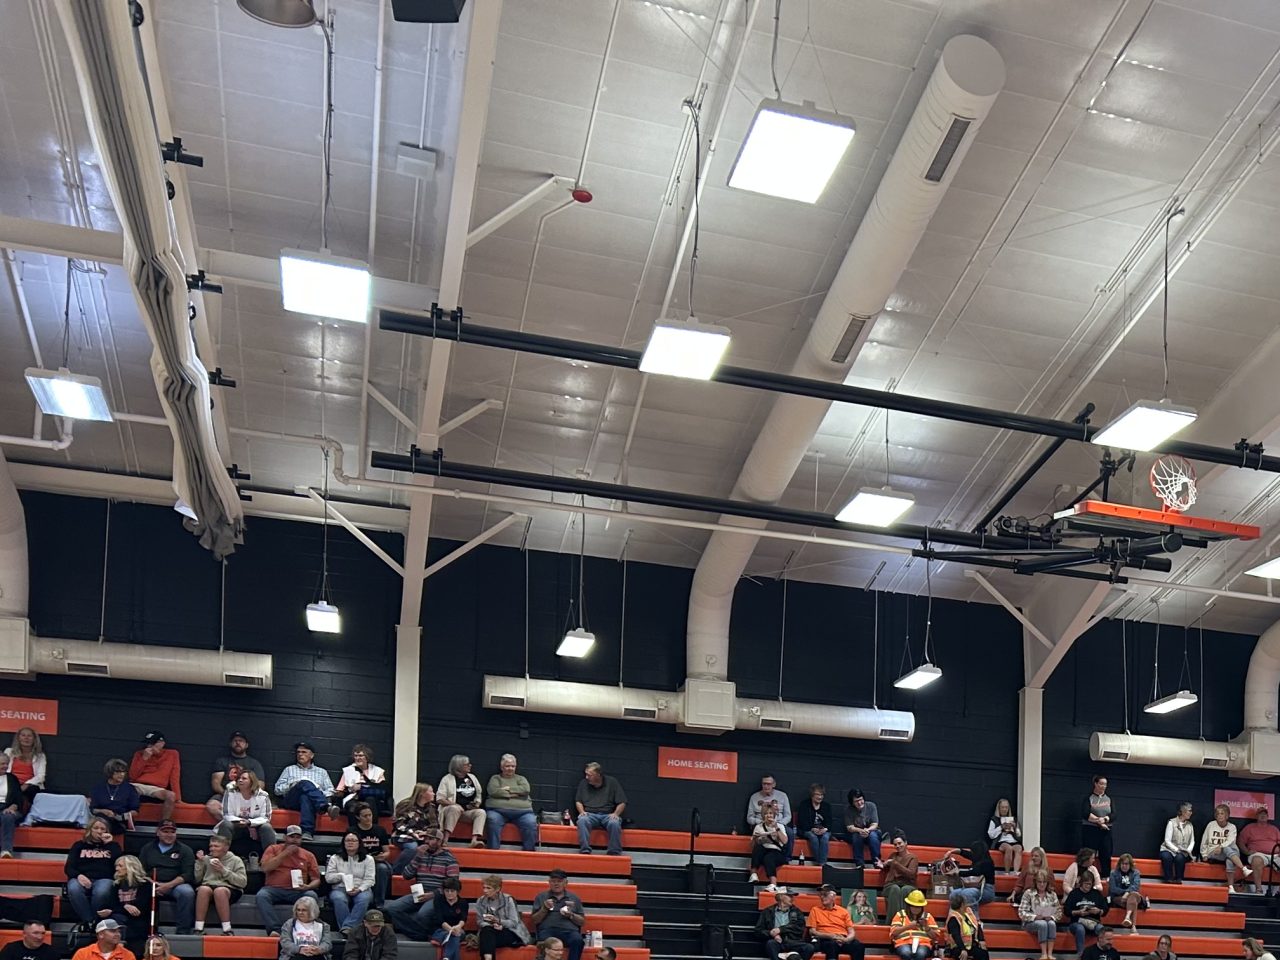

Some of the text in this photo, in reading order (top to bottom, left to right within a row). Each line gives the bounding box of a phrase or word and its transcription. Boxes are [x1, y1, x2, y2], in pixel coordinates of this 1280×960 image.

[0, 709, 46, 721] SEATING
[667, 759, 729, 770] HOME SEATING
